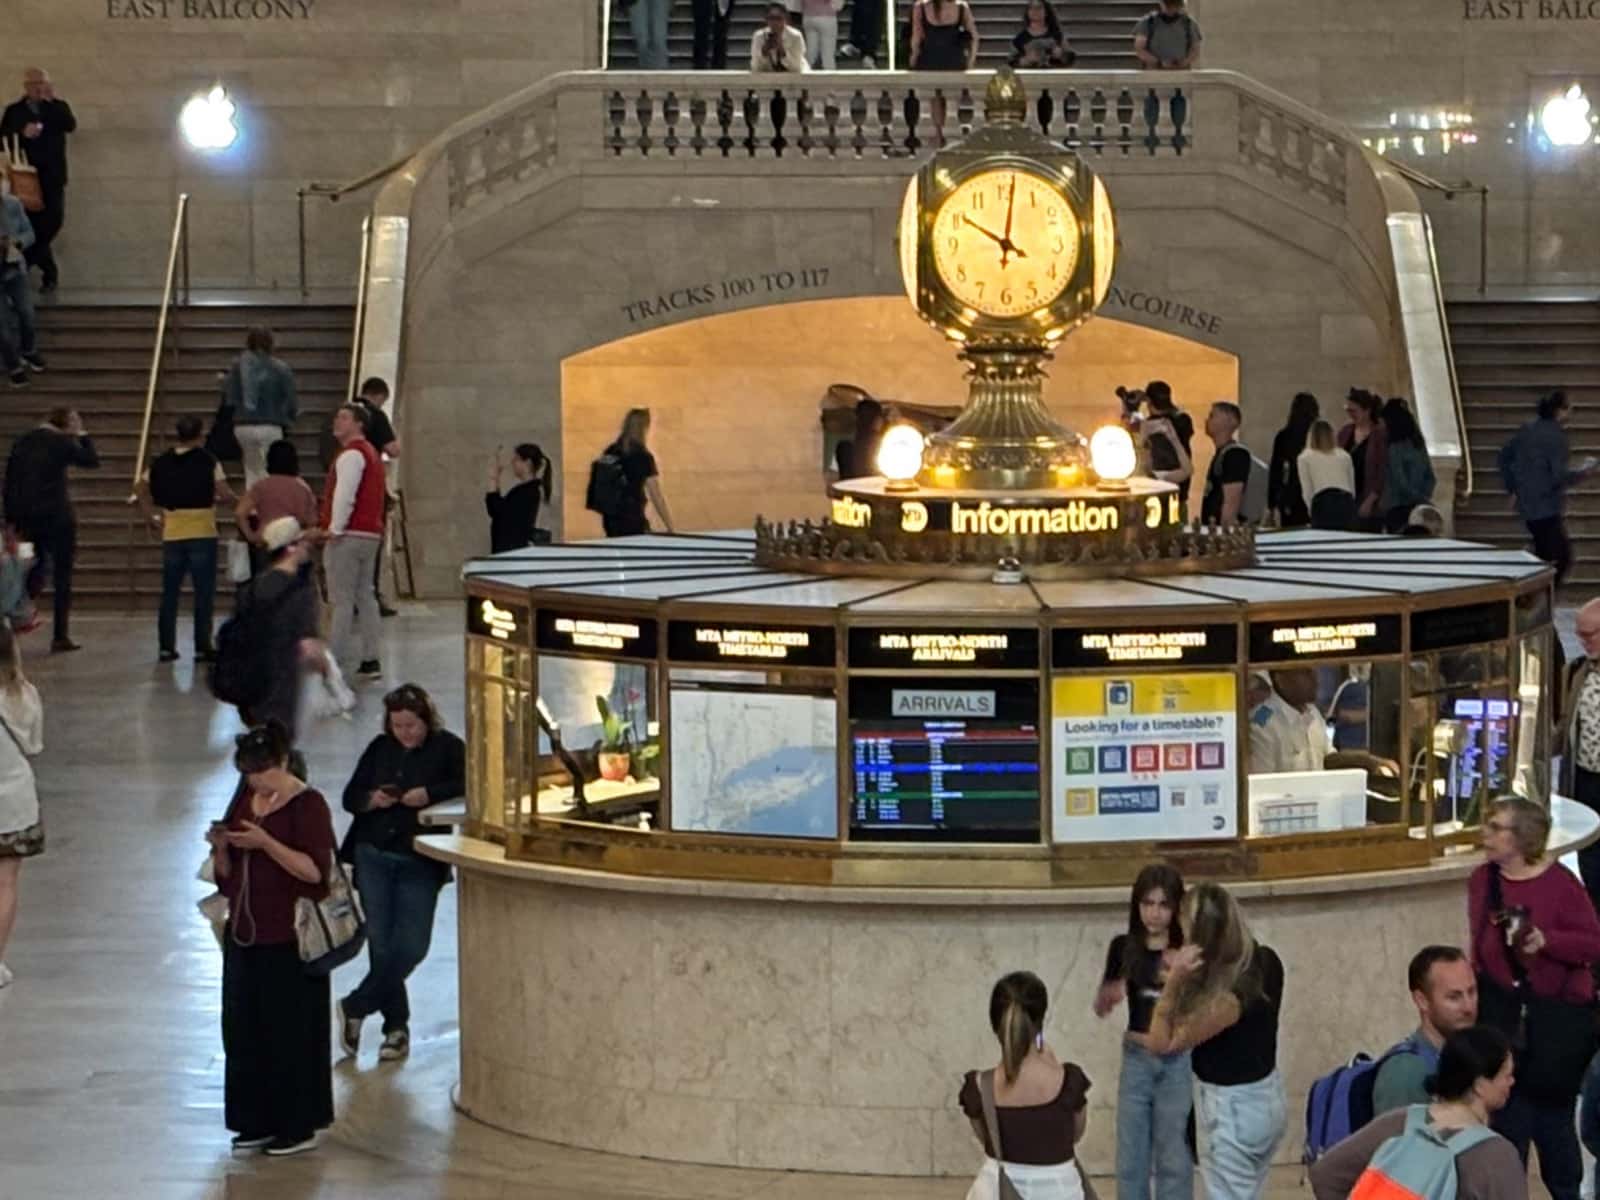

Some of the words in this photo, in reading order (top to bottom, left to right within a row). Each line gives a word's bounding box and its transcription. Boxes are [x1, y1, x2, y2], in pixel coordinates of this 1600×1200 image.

[107, 0, 171, 19] EAST
[183, 0, 315, 19] BALCONY
[1463, 0, 1526, 19] EAST
[972, 191, 984, 210] 11
[1030, 191, 1036, 208] 1
[948, 236, 959, 255] 9
[1051, 235, 1064, 255] 3
[956, 264, 967, 282] 8
[1046, 263, 1057, 280] 4
[621, 284, 715, 323] TRACKS
[720, 278, 755, 299] 100
[760, 271, 795, 292] TO
[801, 268, 830, 288] 117
[975, 281, 985, 299] 7
[1000, 288, 1012, 305] 6
[1026, 281, 1038, 300] 5
[1111, 287, 1223, 335] NCOURSE
[951, 499, 1119, 533] Information
[899, 696, 990, 712] ARRIVALS
[1065, 720, 1118, 735] Looking
[1120, 719, 1140, 731] for
[1142, 720, 1149, 730] a
[1152, 716, 1224, 730] timetable?
